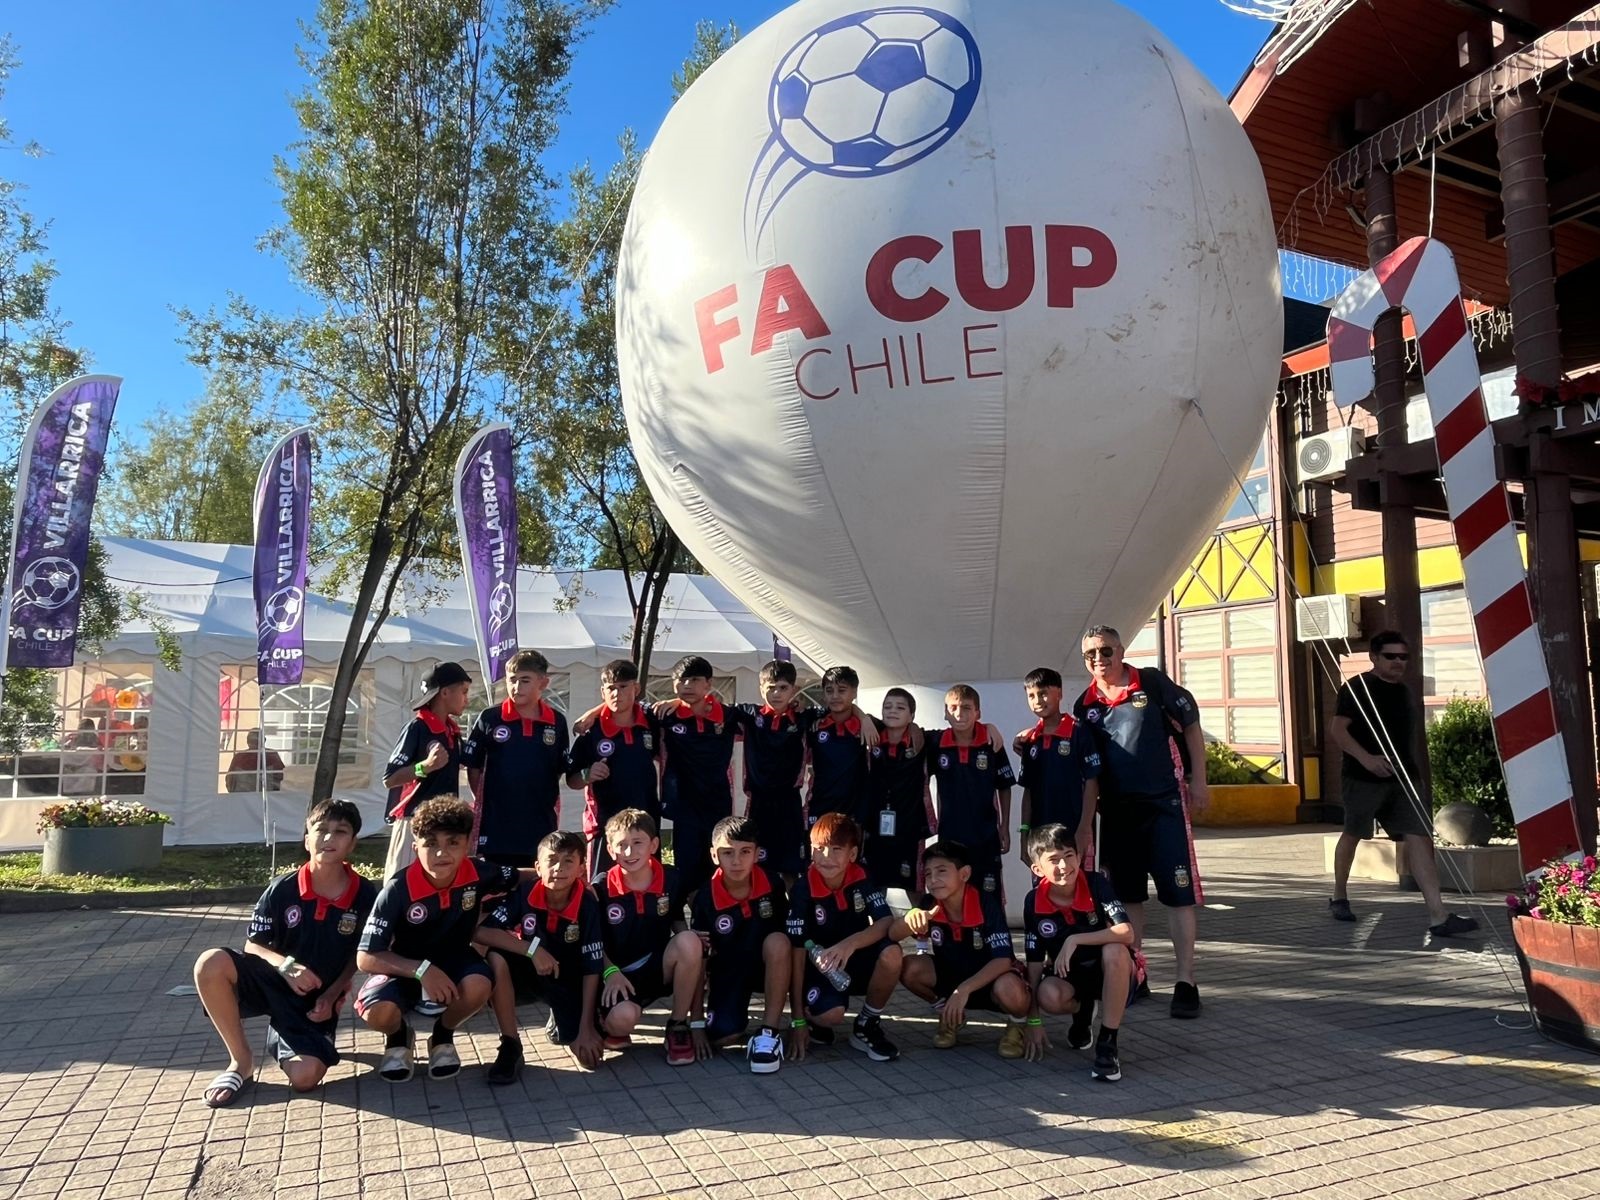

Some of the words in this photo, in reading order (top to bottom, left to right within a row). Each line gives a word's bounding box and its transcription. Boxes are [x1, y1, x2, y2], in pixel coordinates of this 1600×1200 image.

[694, 263, 832, 374] FA
[865, 223, 1118, 322] CUP
[795, 323, 1003, 400] CHILE
[43, 401, 92, 549] VILLARRICA
[277, 456, 295, 585] VILLARRICA
[478, 450, 505, 578] VILLARRICA
[16, 640, 53, 650] CHILE
[33, 627, 74, 642] CUP
[272, 647, 303, 660] CUP
